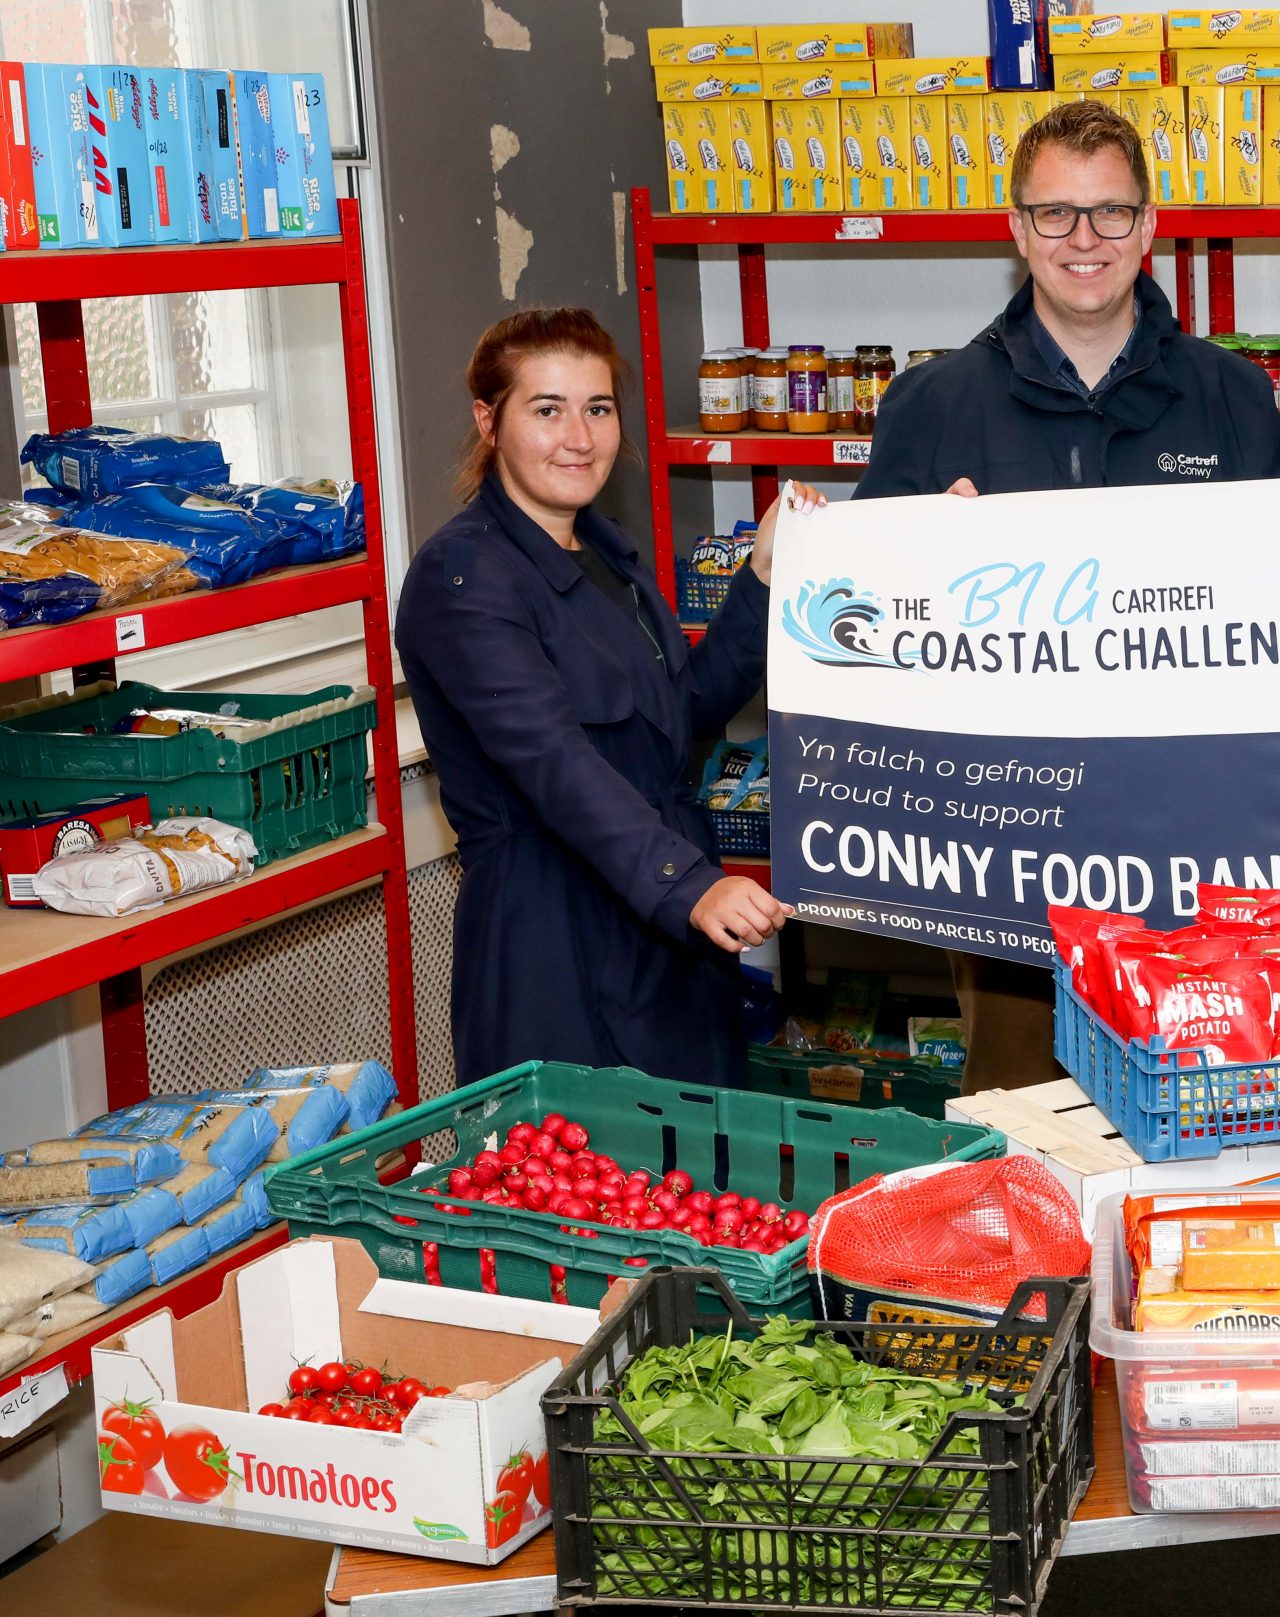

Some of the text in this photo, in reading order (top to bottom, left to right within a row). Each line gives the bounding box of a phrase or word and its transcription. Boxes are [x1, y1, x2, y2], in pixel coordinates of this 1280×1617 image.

[70, 92, 82, 131] Rice
[219, 182, 230, 215] Bran
[228, 178, 239, 220] Flakes
[309, 178, 321, 212] Rice
[1177, 454, 1219, 466] Cartrefi
[1178, 465, 1211, 479] Conwy
[893, 558, 1214, 628] THE BIG CARTREFI
[892, 630, 1080, 674] COASTAL
[798, 736, 1085, 791] Yn falch o gefnogi
[798, 774, 1065, 829] Proud to support
[57, 820, 90, 840] BARESA
[61, 835, 88, 849] LASAGNE
[145, 859, 164, 894] CIVITA
[801, 820, 994, 898] CONWY
[1012, 849, 1154, 914] FOOD
[797, 902, 1057, 955] PROVIDES FOOD PARCELS TO PEOP
[1171, 981, 1228, 993] INSTANT
[1164, 994, 1244, 1023] MASH
[1181, 1022, 1231, 1038] POTATO
[844, 1293, 854, 1318] VAN
[1, 1382, 40, 1420] RICE
[236, 1452, 398, 1513] Tomatoes
